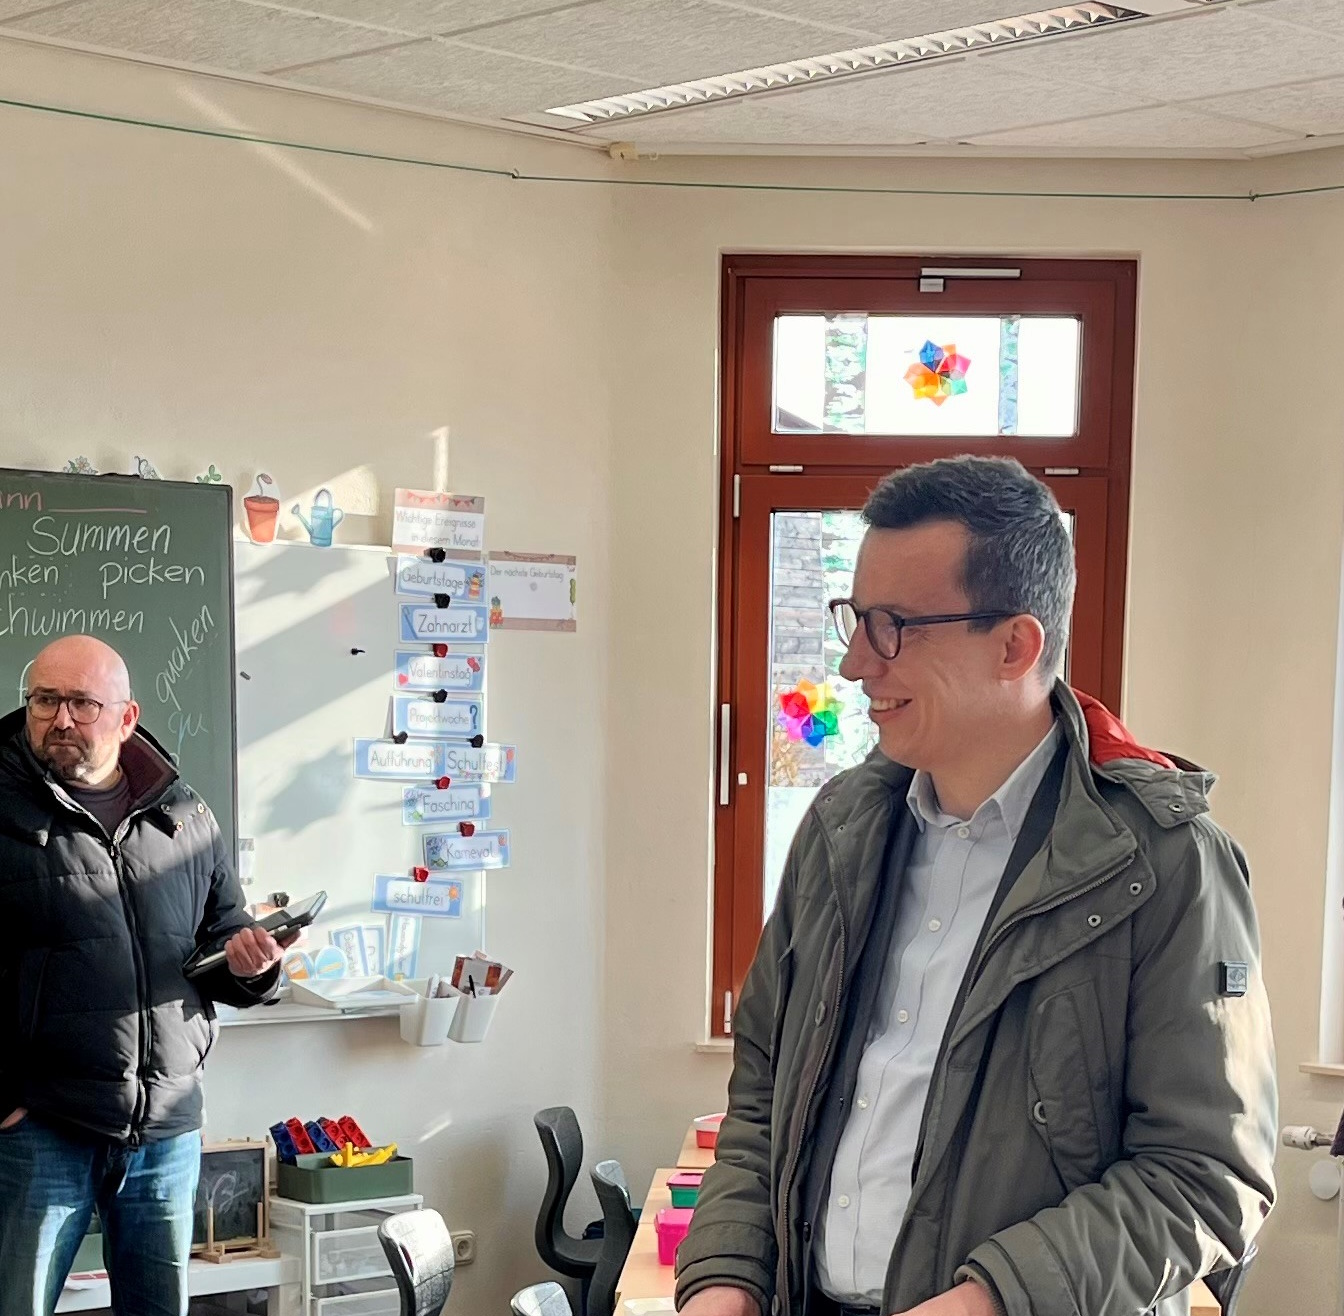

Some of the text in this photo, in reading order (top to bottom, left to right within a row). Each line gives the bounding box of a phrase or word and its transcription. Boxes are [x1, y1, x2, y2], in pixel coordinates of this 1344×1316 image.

[453, 533, 480, 547] Monat
[99, 558, 205, 600] picken
[402, 566, 464, 595] Geburtstage
[418, 614, 473, 634] Zahnarzt
[156, 605, 215, 711] quaken
[409, 662, 472, 687] Valentinstag
[409, 705, 469, 728] Projektwoche
[370, 750, 433, 774] Aufführung
[447, 750, 504, 771] Schulfest
[423, 794, 475, 817] Fasching
[446, 840, 494, 860] Karneval
